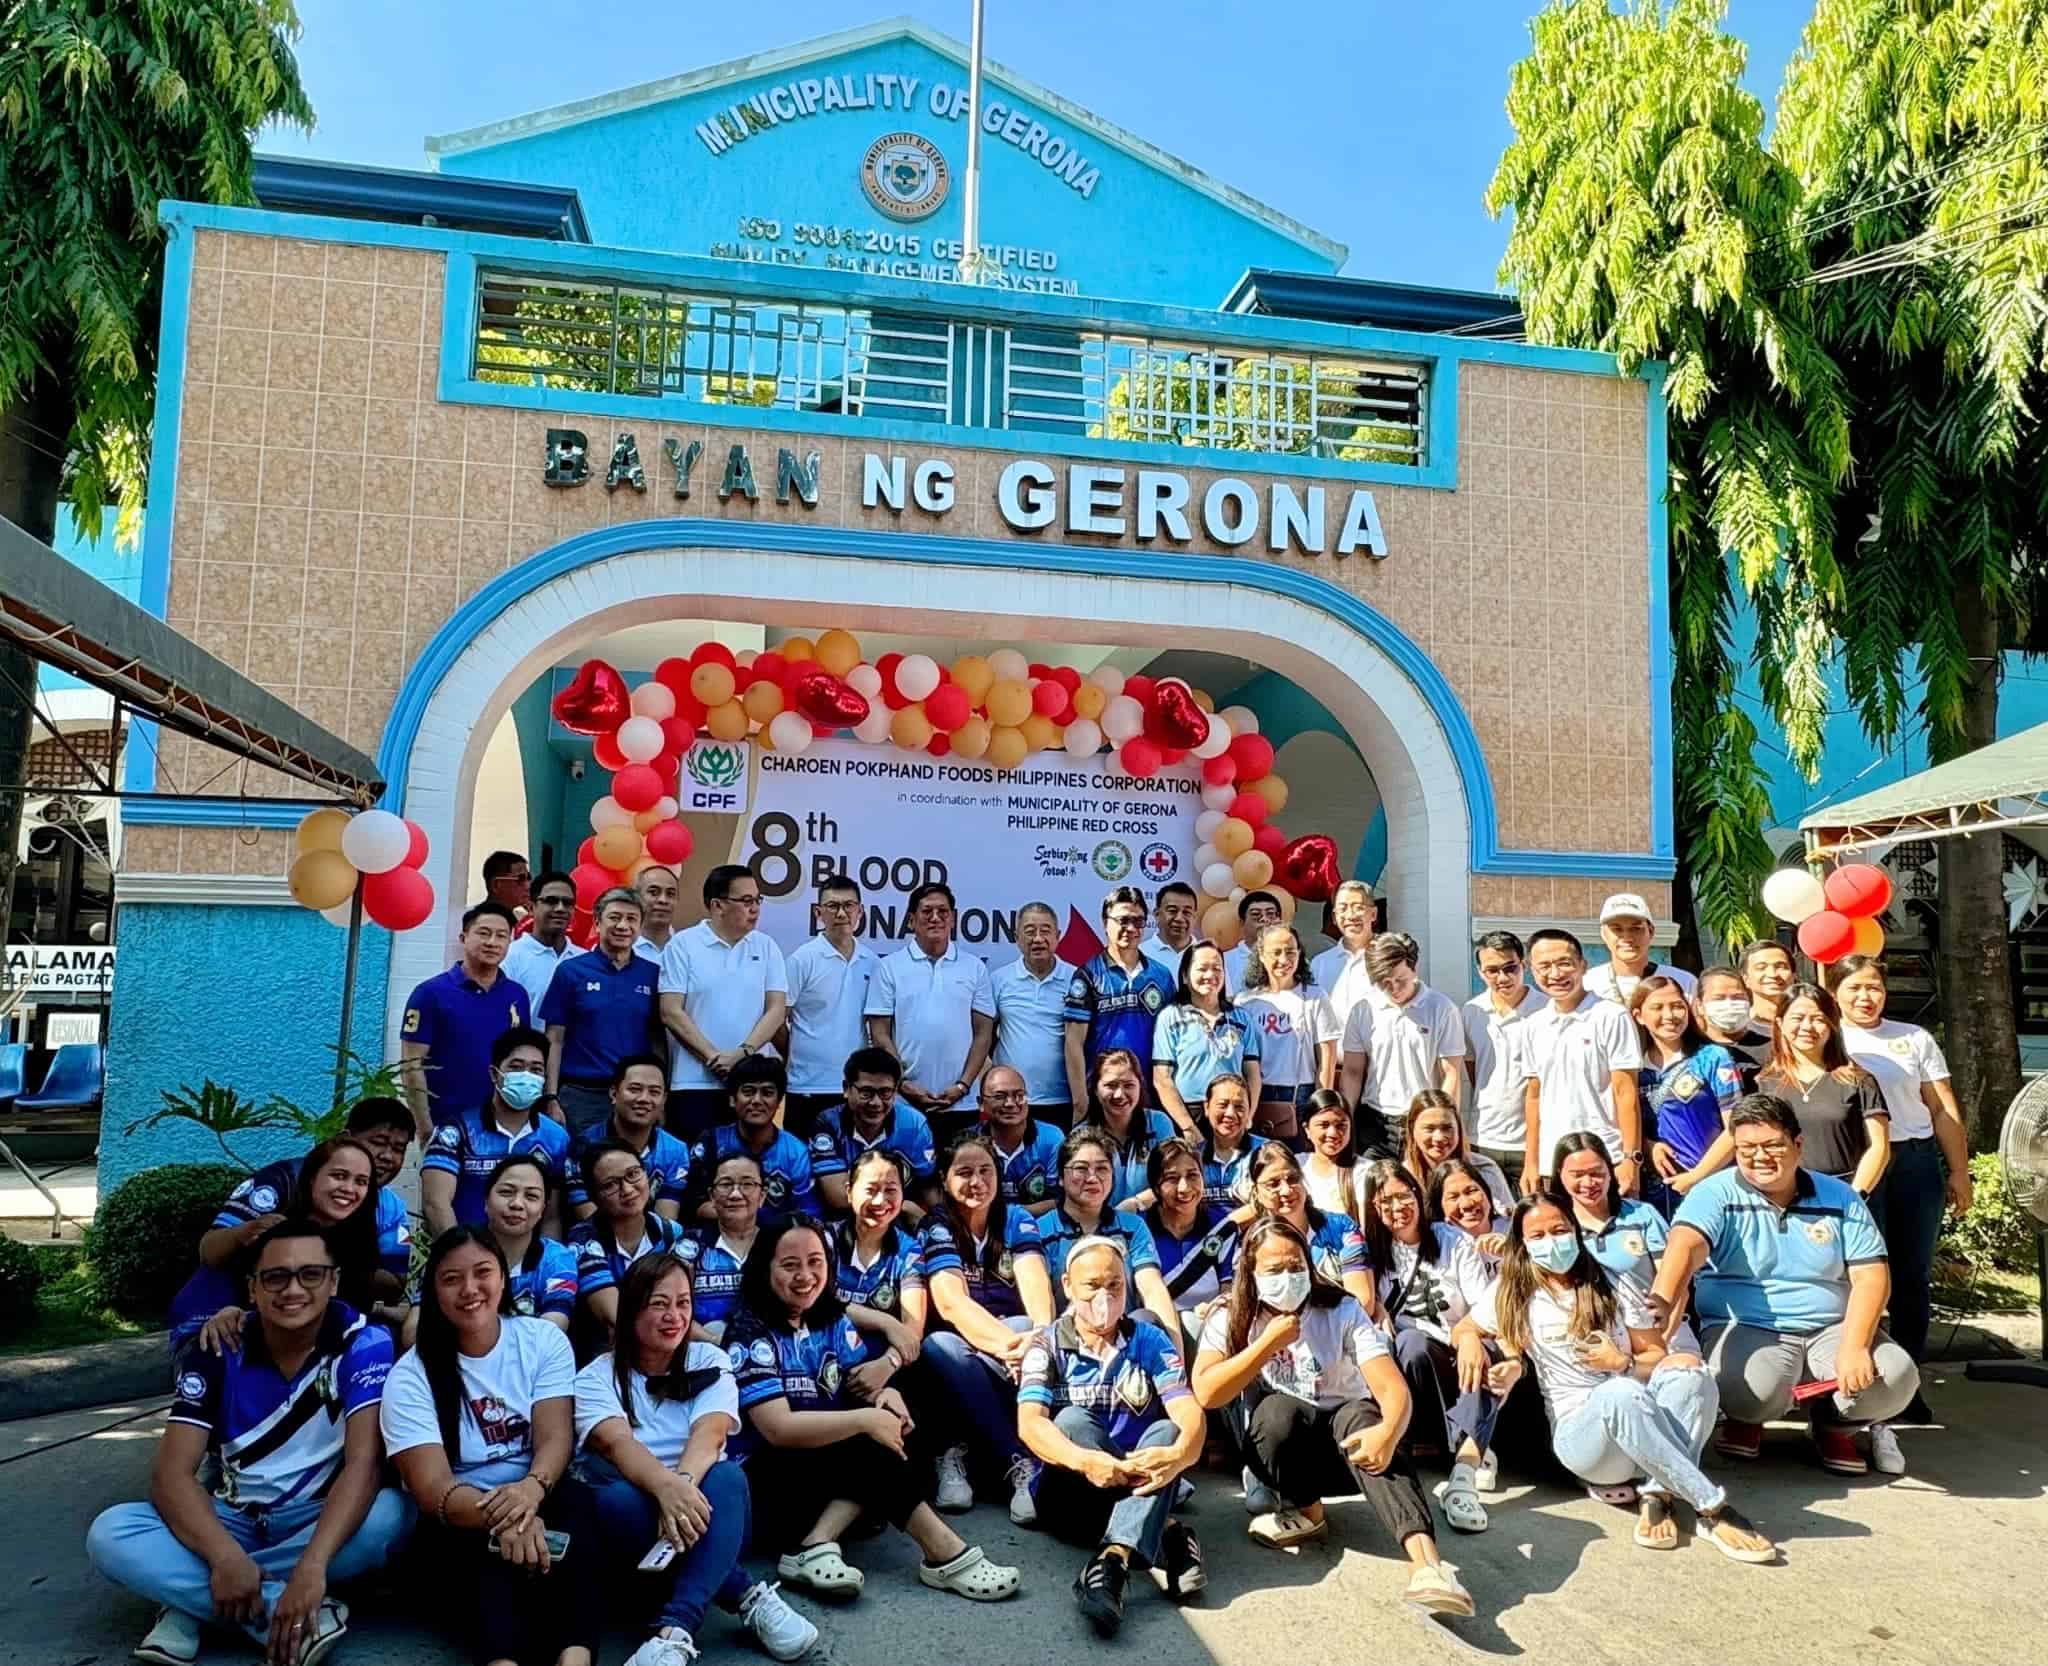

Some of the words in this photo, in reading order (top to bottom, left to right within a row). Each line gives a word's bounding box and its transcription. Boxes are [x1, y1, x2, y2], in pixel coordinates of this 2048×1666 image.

[696, 72, 920, 156] MUNICIPALITY
[931, 83, 971, 122] OF
[982, 102, 1101, 199] GERONA
[933, 238, 1058, 271] CETIFIED
[544, 428, 821, 507] BAYAN
[861, 453, 955, 514] NG
[998, 460, 1390, 559] GERONA
[761, 756, 841, 776] CHAROEN
[845, 761, 934, 780] POKPHAND
[938, 766, 993, 783] FOODS
[998, 769, 1087, 788] PHILIPPINES
[1091, 775, 1201, 794] CORPORATION
[692, 793, 736, 808] CPF
[897, 791, 907, 802] in
[910, 792, 977, 806] coordination
[981, 796, 1002, 807] with
[1008, 796, 1099, 813] MUNICIPALITY
[1102, 801, 1120, 814] OF
[1124, 802, 1178, 817] GERONA
[1007, 815, 1081, 832] PHILIPPINE
[1082, 819, 1109, 832] RED
[1112, 820, 1158, 836] CROSS
[404, 1010, 420, 1033] 3
